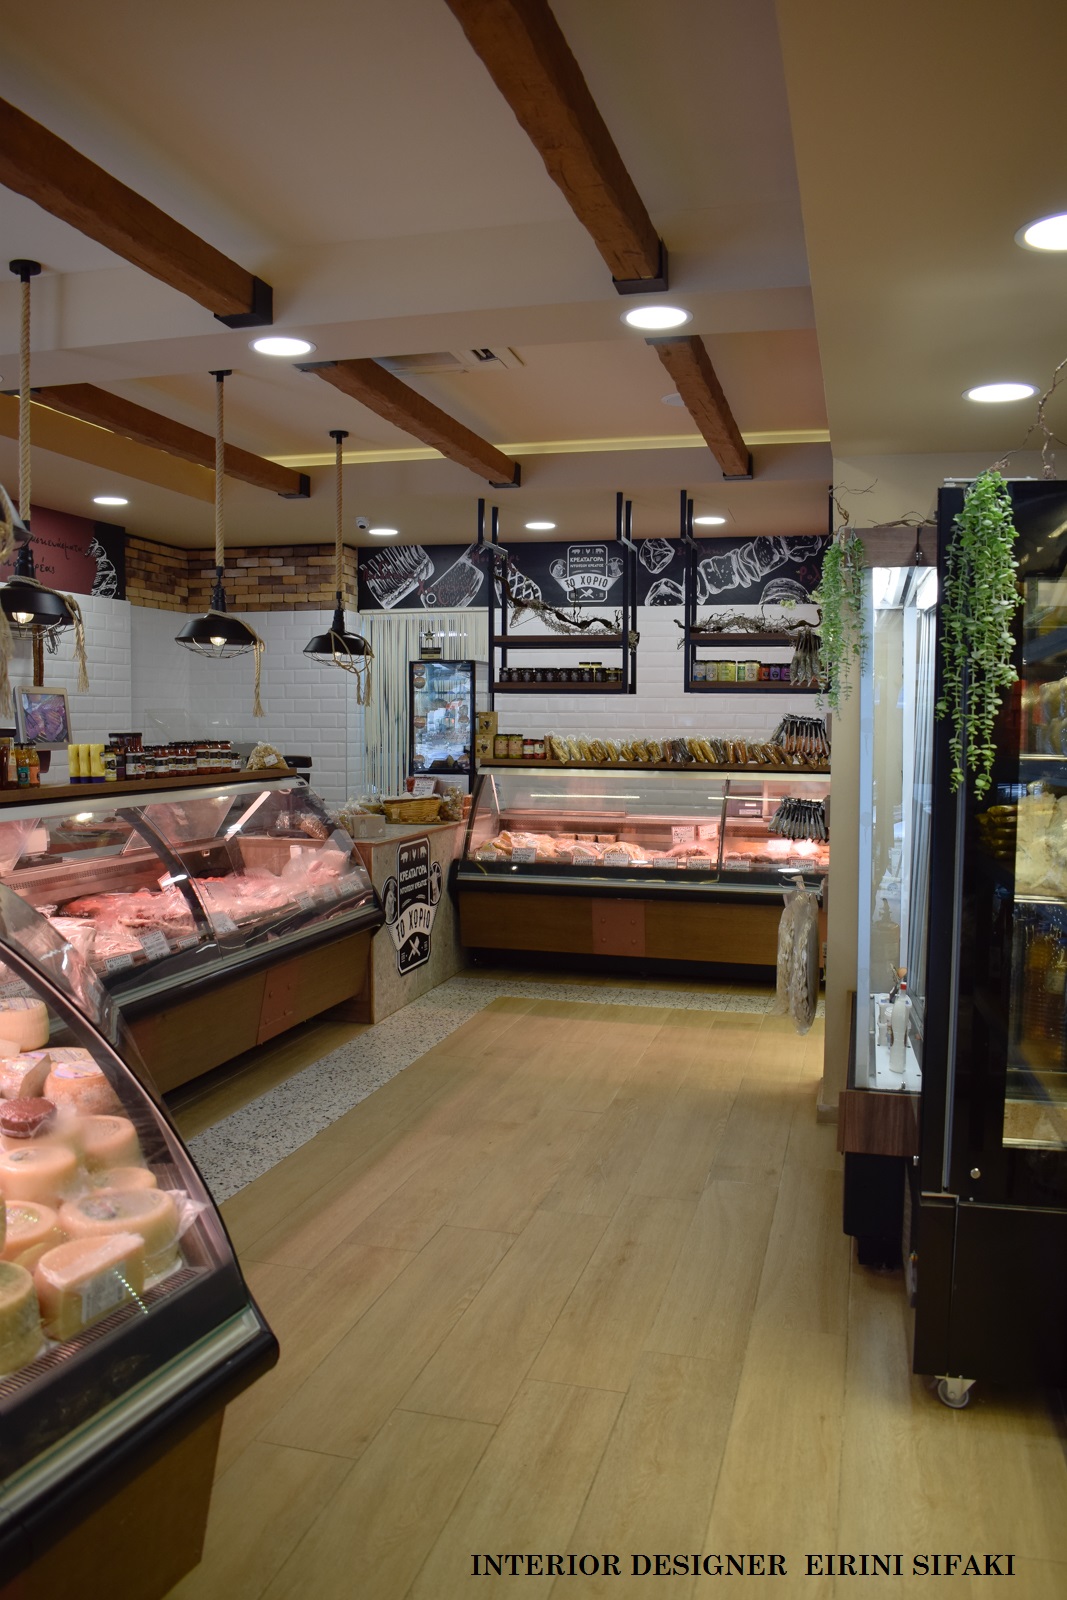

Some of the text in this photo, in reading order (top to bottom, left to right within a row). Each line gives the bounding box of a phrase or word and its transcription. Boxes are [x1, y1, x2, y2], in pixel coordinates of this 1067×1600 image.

[35, 557, 55, 574] ρέας
[400, 865, 427, 882] ΚΡΕΑΤΑΓΟΡΑ
[396, 919, 404, 942] ΤΟ
